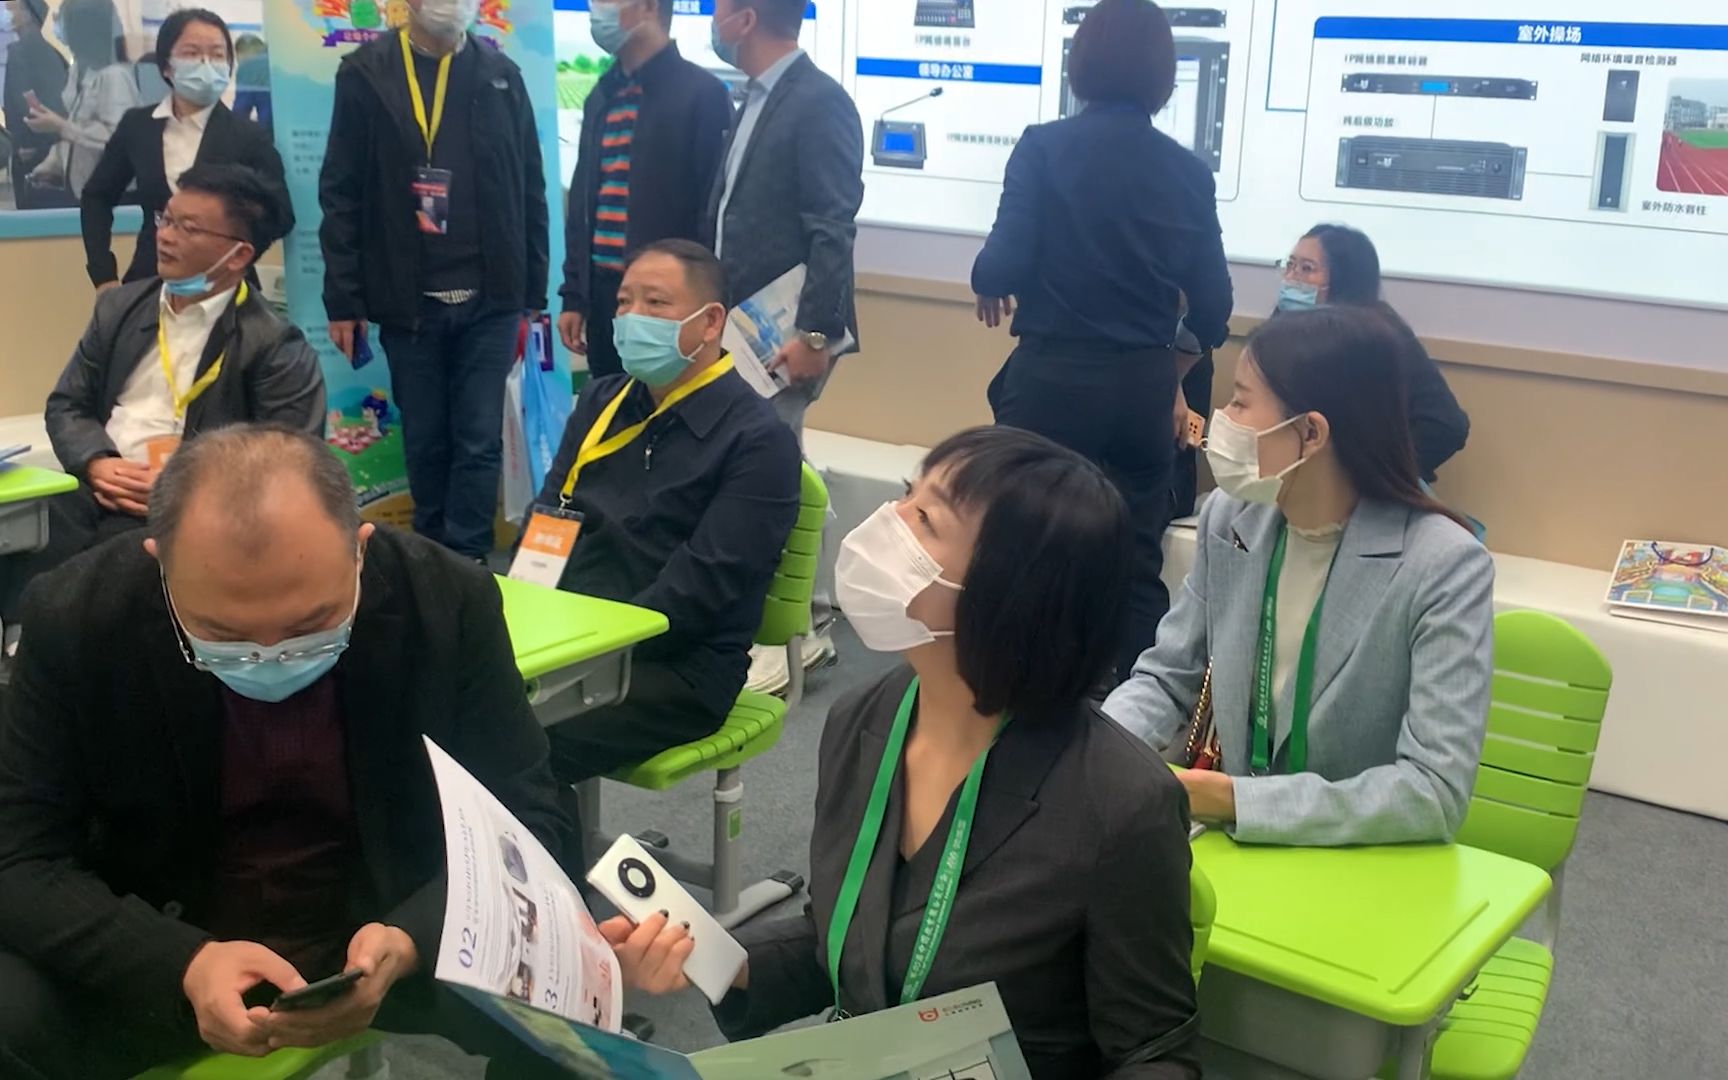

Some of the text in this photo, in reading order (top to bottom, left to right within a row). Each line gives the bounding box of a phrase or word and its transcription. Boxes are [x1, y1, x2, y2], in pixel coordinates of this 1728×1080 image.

[1517, 25, 1582, 43] 室外操场
[459, 927, 477, 969] 02
